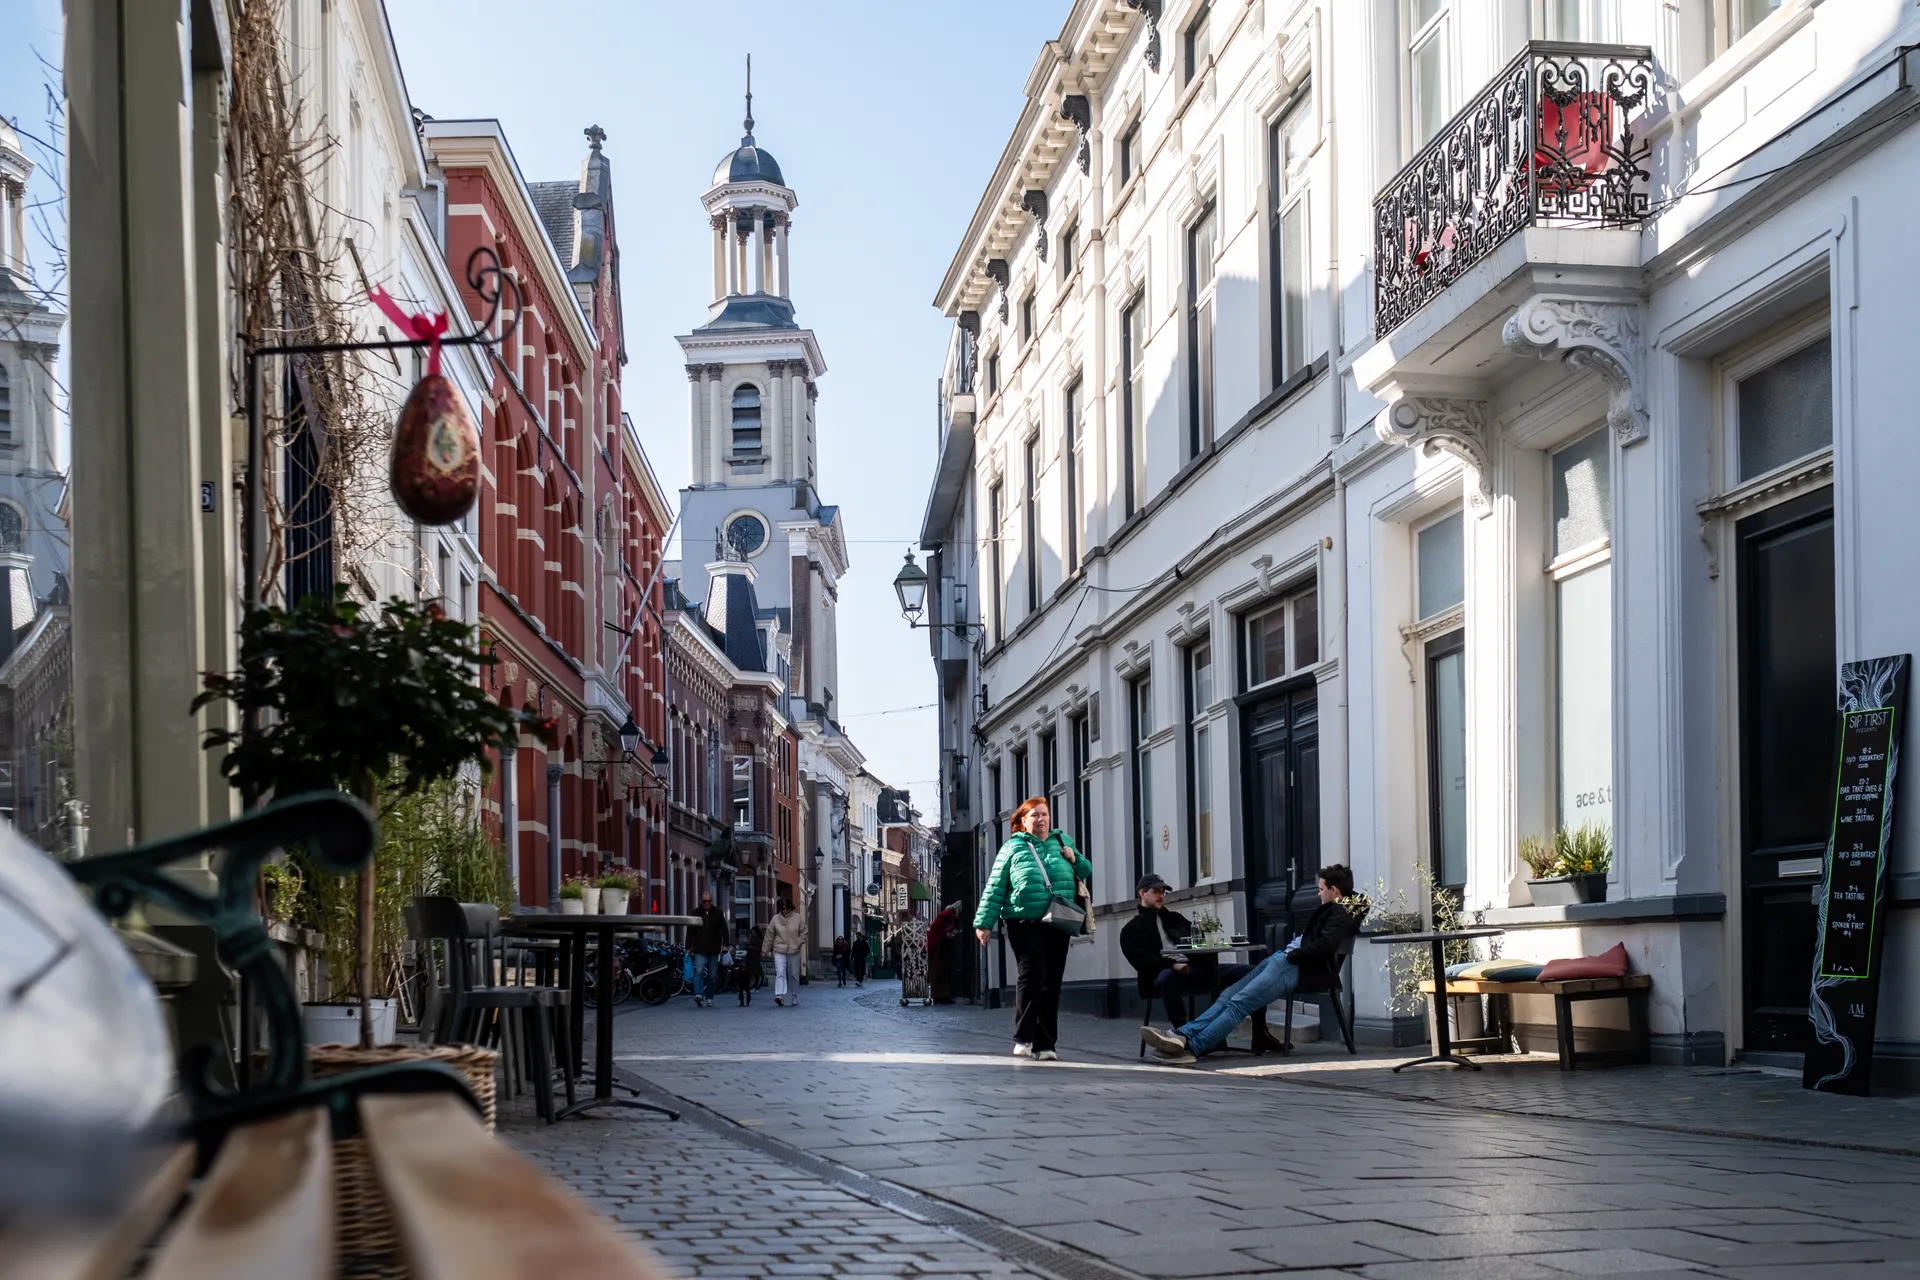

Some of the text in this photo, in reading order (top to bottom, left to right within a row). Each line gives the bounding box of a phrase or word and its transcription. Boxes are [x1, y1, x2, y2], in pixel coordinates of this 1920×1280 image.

[1849, 711, 1888, 729] SIP FIRST
[1859, 753, 1884, 761] BREAKFAST
[1840, 783, 1883, 795] BAR TAKE OVER &
[1576, 792, 1595, 809] ace
[1598, 787, 1606, 805] &
[1855, 814, 1875, 822] TASTING
[1851, 850, 1876, 859] BREAKFAST
[899, 887, 907, 907] ellis
[1833, 891, 1866, 901] TEA TASTING
[1851, 922, 1865, 930] FIRST
